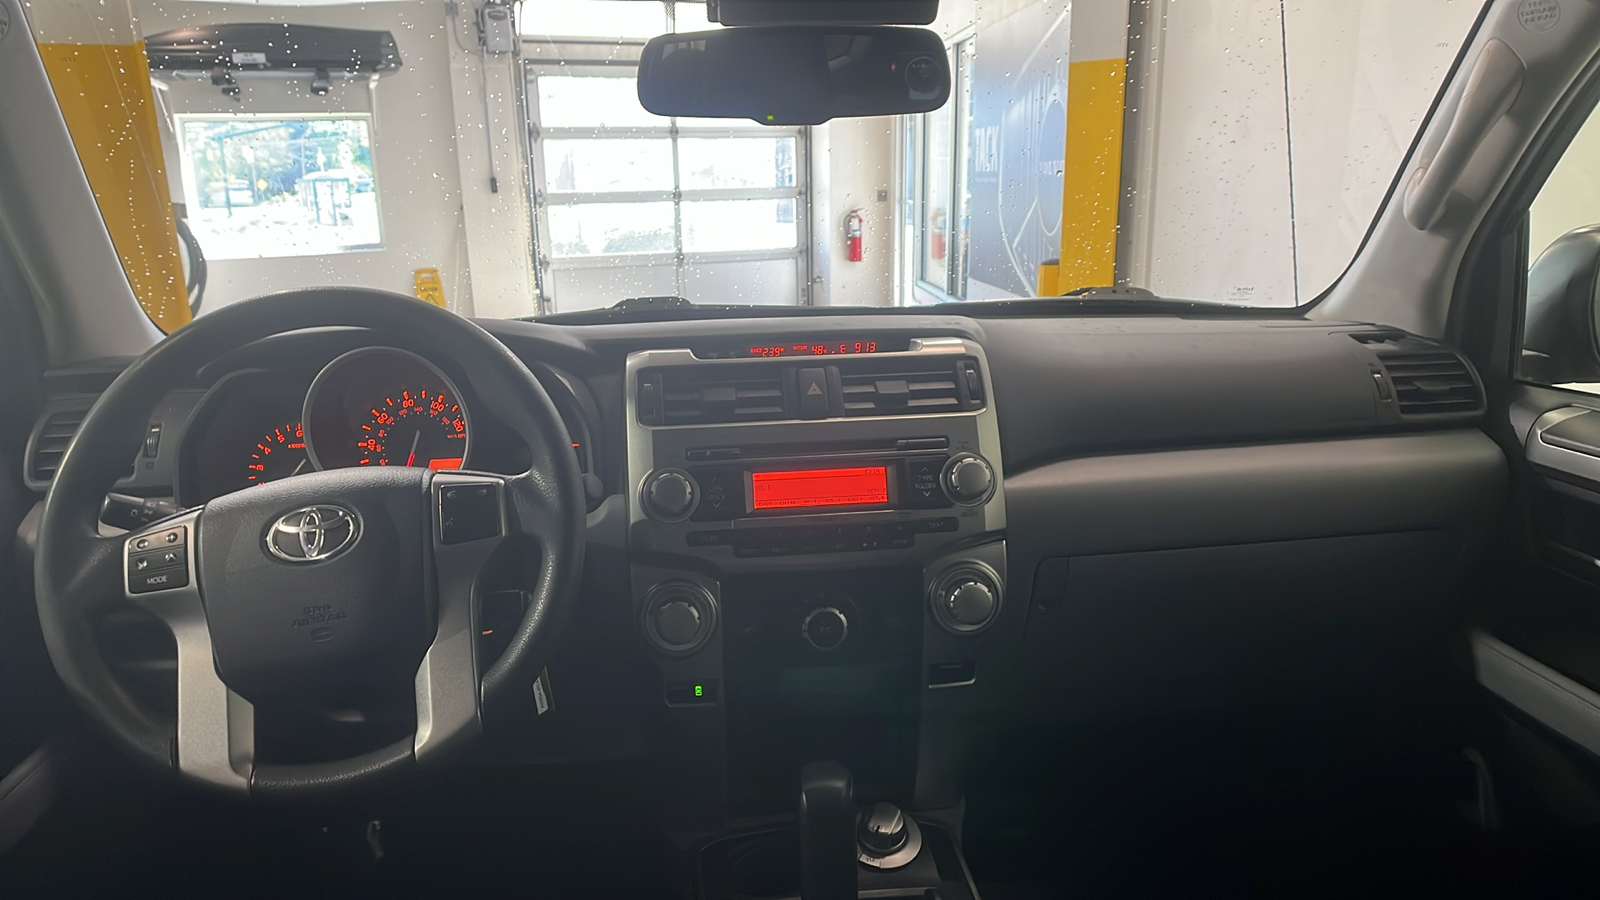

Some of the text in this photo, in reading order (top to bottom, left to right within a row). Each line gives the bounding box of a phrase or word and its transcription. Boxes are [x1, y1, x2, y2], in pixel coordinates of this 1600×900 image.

[402, 399, 415, 408] 80
[430, 400, 445, 412] 100
[377, 412, 389, 424] 60
[453, 418, 464, 432] 120
[277, 434, 285, 443] 5
[367, 439, 376, 451] 40
[264, 447, 271, 455] 4
[146, 575, 168, 585] MODE
